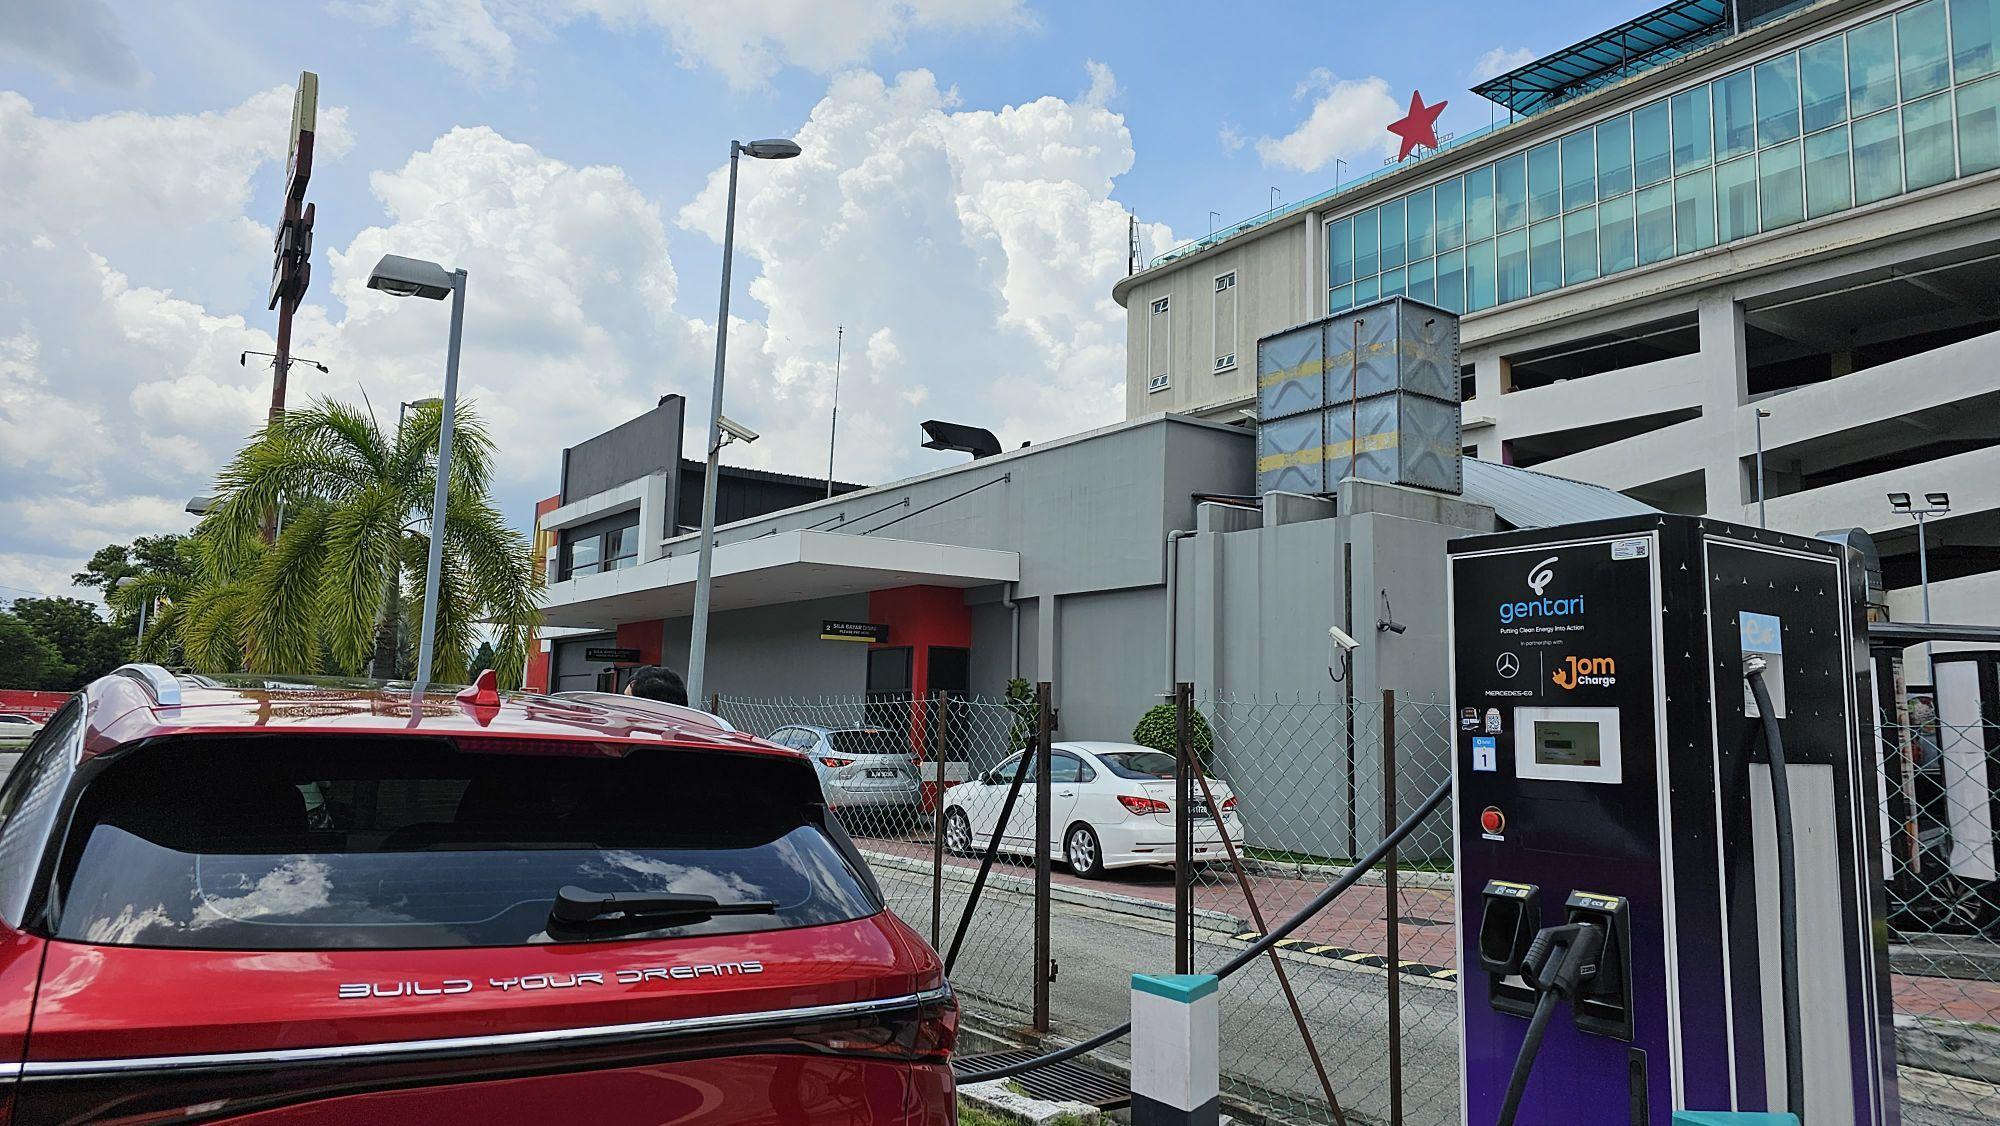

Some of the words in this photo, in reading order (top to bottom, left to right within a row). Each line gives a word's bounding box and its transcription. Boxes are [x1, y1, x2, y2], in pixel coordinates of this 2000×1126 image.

[1499, 594, 1585, 624] gentari
[1560, 655, 1616, 690] Jom
[1577, 676, 1617, 688] Charge
[1481, 753, 1487, 767] 1
[338, 978, 473, 998] BUILD
[488, 971, 604, 991] YOUR
[615, 960, 764, 984] DREAMS
